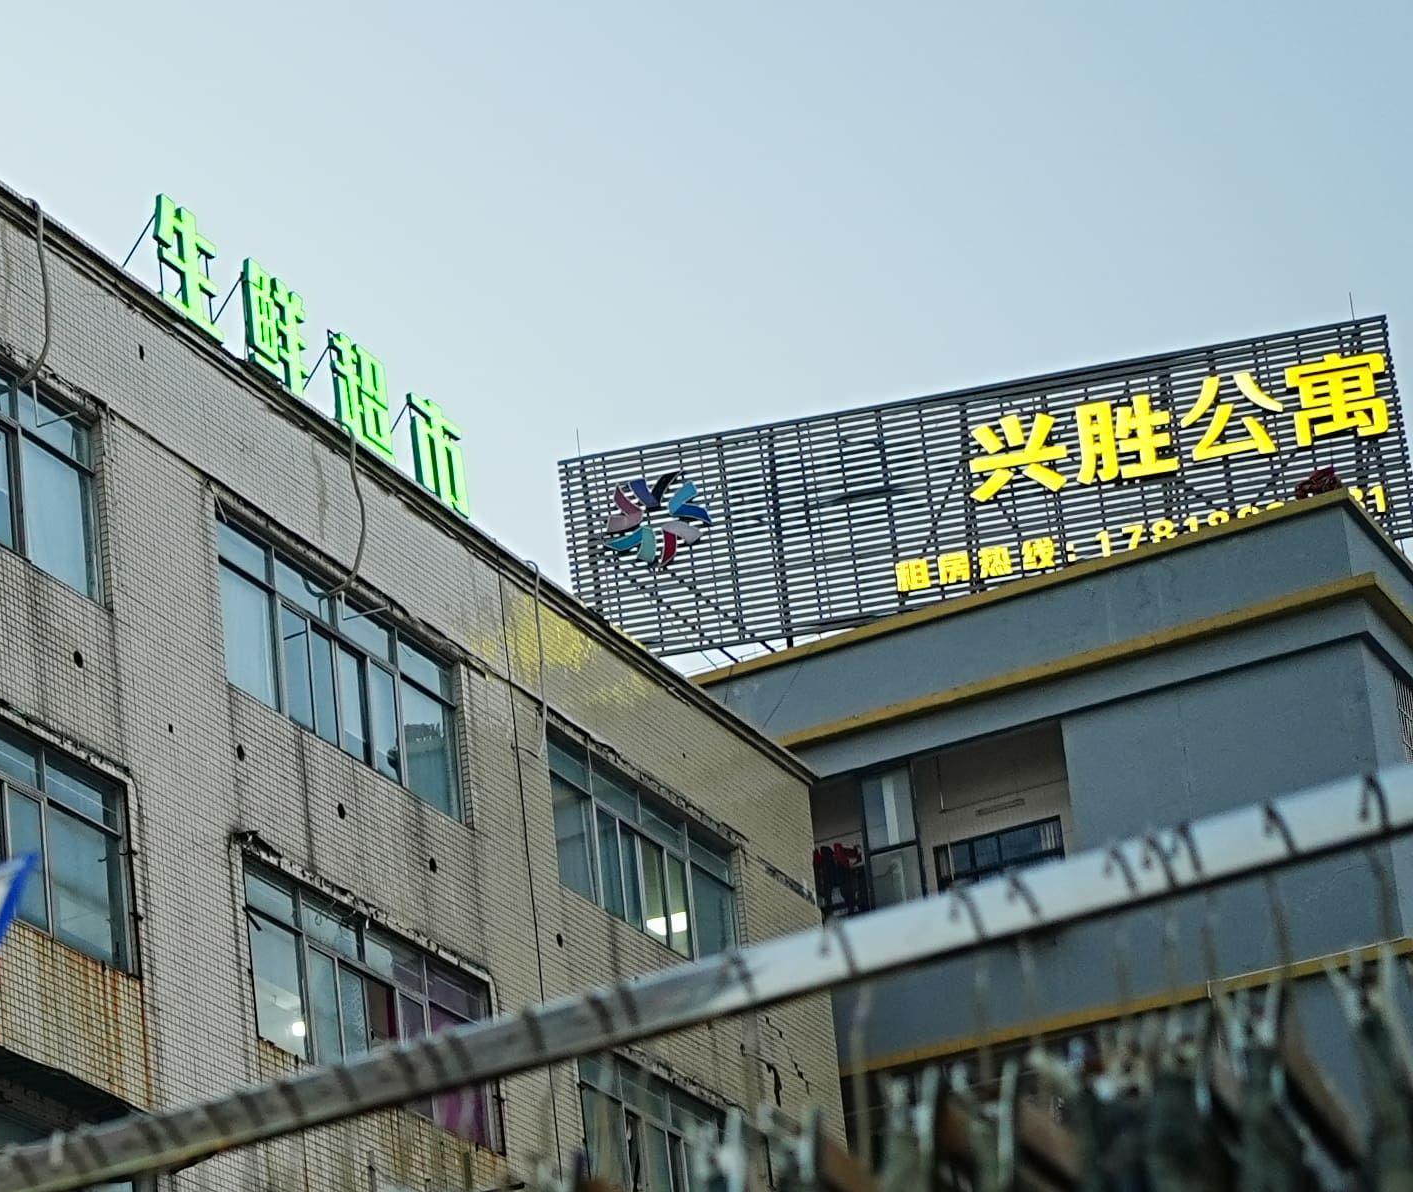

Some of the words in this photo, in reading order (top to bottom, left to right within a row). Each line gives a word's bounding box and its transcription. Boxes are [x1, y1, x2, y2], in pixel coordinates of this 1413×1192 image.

[152, 193, 470, 519] 生鲜超市
[969, 352, 1389, 503] 兴胜公寓
